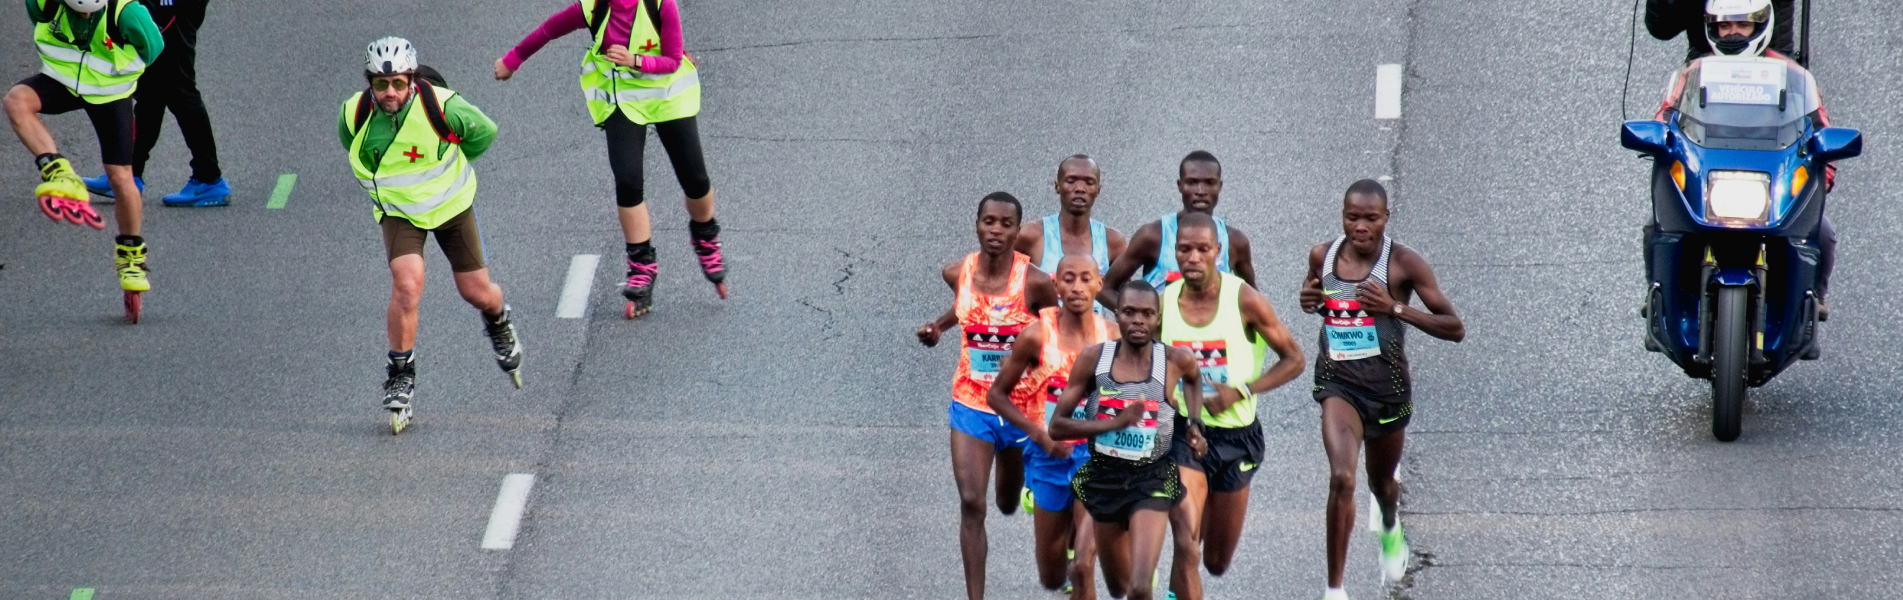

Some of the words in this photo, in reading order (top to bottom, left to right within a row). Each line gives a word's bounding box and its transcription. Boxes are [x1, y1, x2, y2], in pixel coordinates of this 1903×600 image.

[1719, 84, 1763, 94] VEHÍCULO
[1710, 92, 1771, 102] AUTORIZADO
[1114, 431, 1145, 449] 20009
